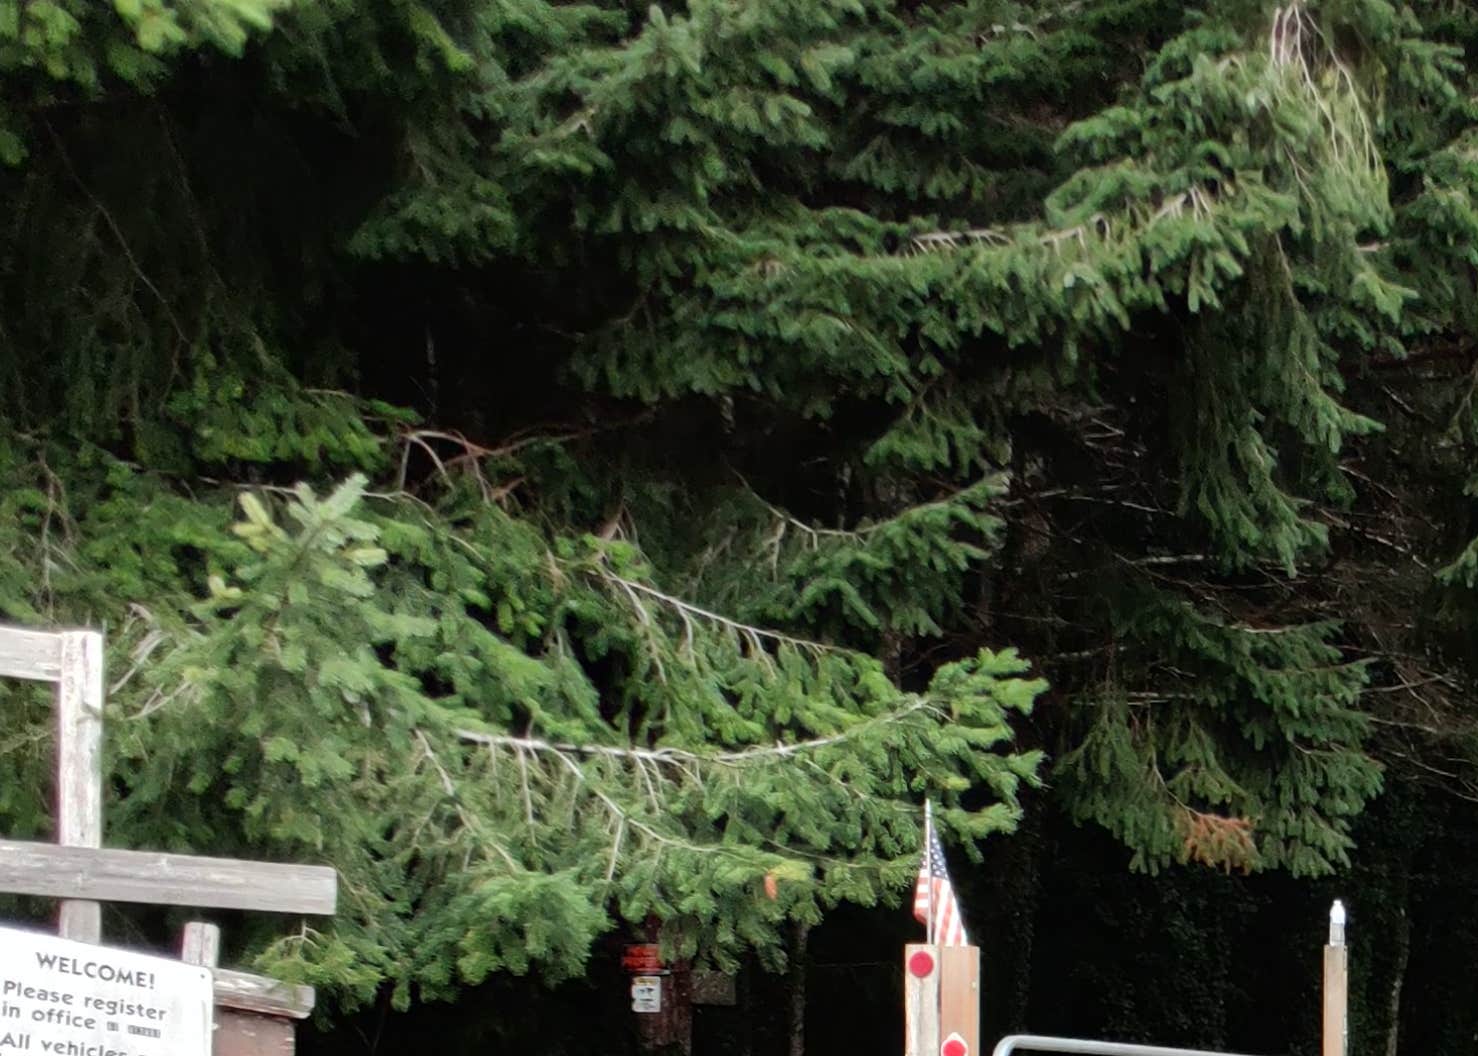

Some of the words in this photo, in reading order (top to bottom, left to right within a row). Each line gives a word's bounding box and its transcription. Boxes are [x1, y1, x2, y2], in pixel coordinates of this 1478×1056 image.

[35, 951, 156, 990] WELCOME!
[2, 1001, 21, 1019] in
[31, 1008, 96, 1030] office
[3, 980, 74, 1006] Please
[84, 994, 167, 1021] register
[0, 1032, 30, 1050] All
